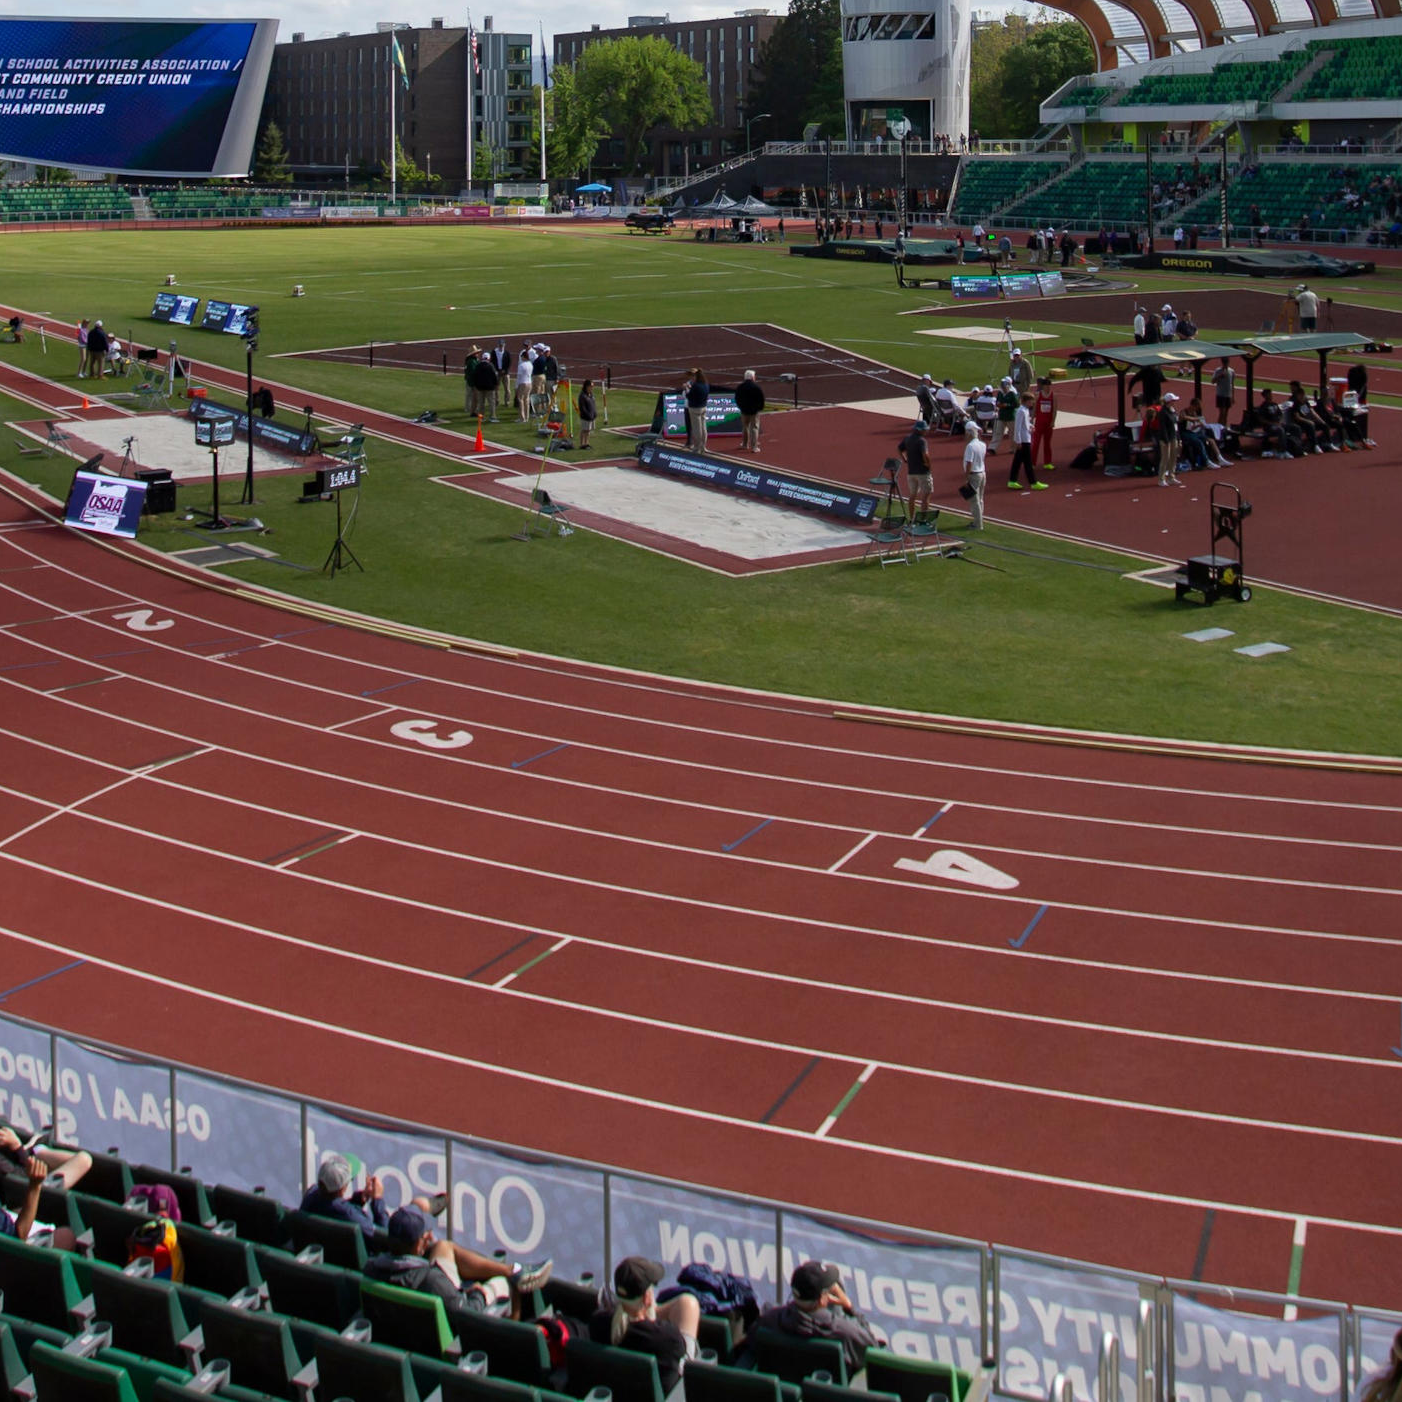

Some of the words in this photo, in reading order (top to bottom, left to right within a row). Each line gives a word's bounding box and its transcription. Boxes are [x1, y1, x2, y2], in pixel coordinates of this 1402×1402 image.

[7, 59, 60, 70] SCHOOL
[63, 59, 139, 70] ACTIVITIES
[141, 59, 231, 71] ASSOCIATION
[12, 73, 95, 85] COMMUNITY
[96, 73, 146, 85] CREDIT
[148, 74, 192, 85] UNION
[28, 88, 69, 100] FIELD
[1161, 257, 1214, 269] OREGON
[737, 470, 760, 484] OnPoint
[88, 494, 124, 514] OSAA
[111, 609, 176, 632] 2
[389, 719, 474, 749] 3
[892, 848, 1020, 890] 4
